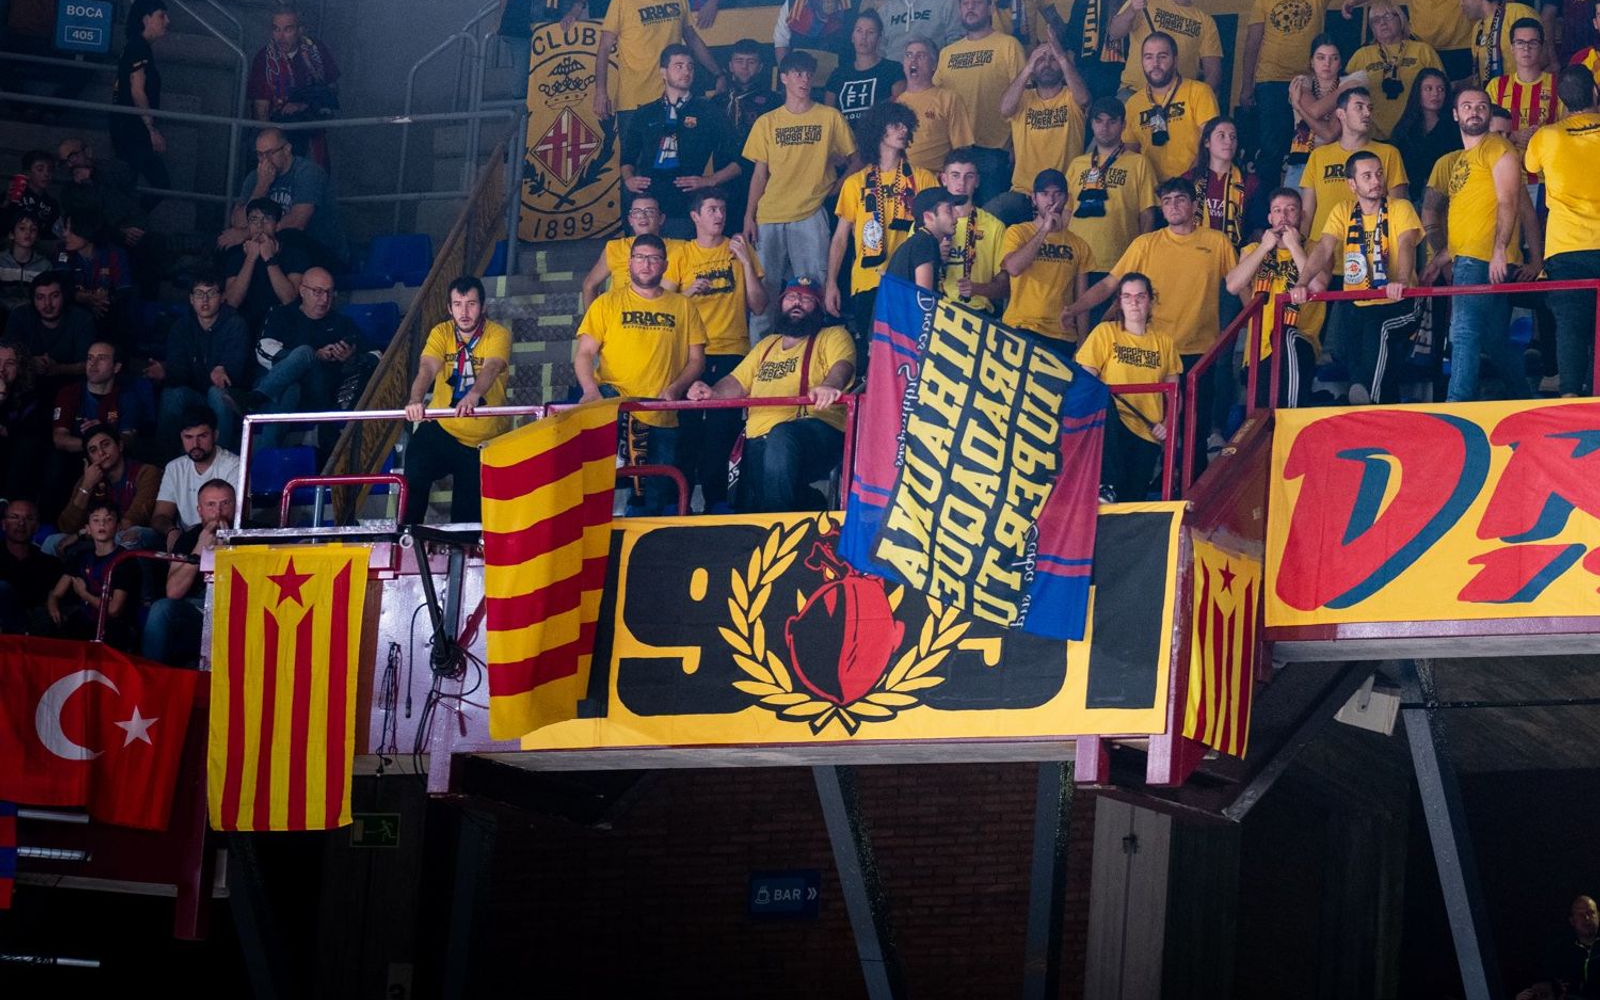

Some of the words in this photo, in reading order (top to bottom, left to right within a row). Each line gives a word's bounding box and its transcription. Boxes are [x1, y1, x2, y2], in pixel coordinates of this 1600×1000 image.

[66, 4, 103, 18] BOCA
[638, 2, 681, 21] DRACS
[72, 29, 94, 41] 405
[532, 30, 596, 56] CLUB
[775, 125, 822, 136] SUPPORTERS
[533, 213, 594, 240] 1899
[1039, 243, 1073, 260] RACS
[621, 311, 675, 328] DRACS
[773, 887, 802, 903] BAR
